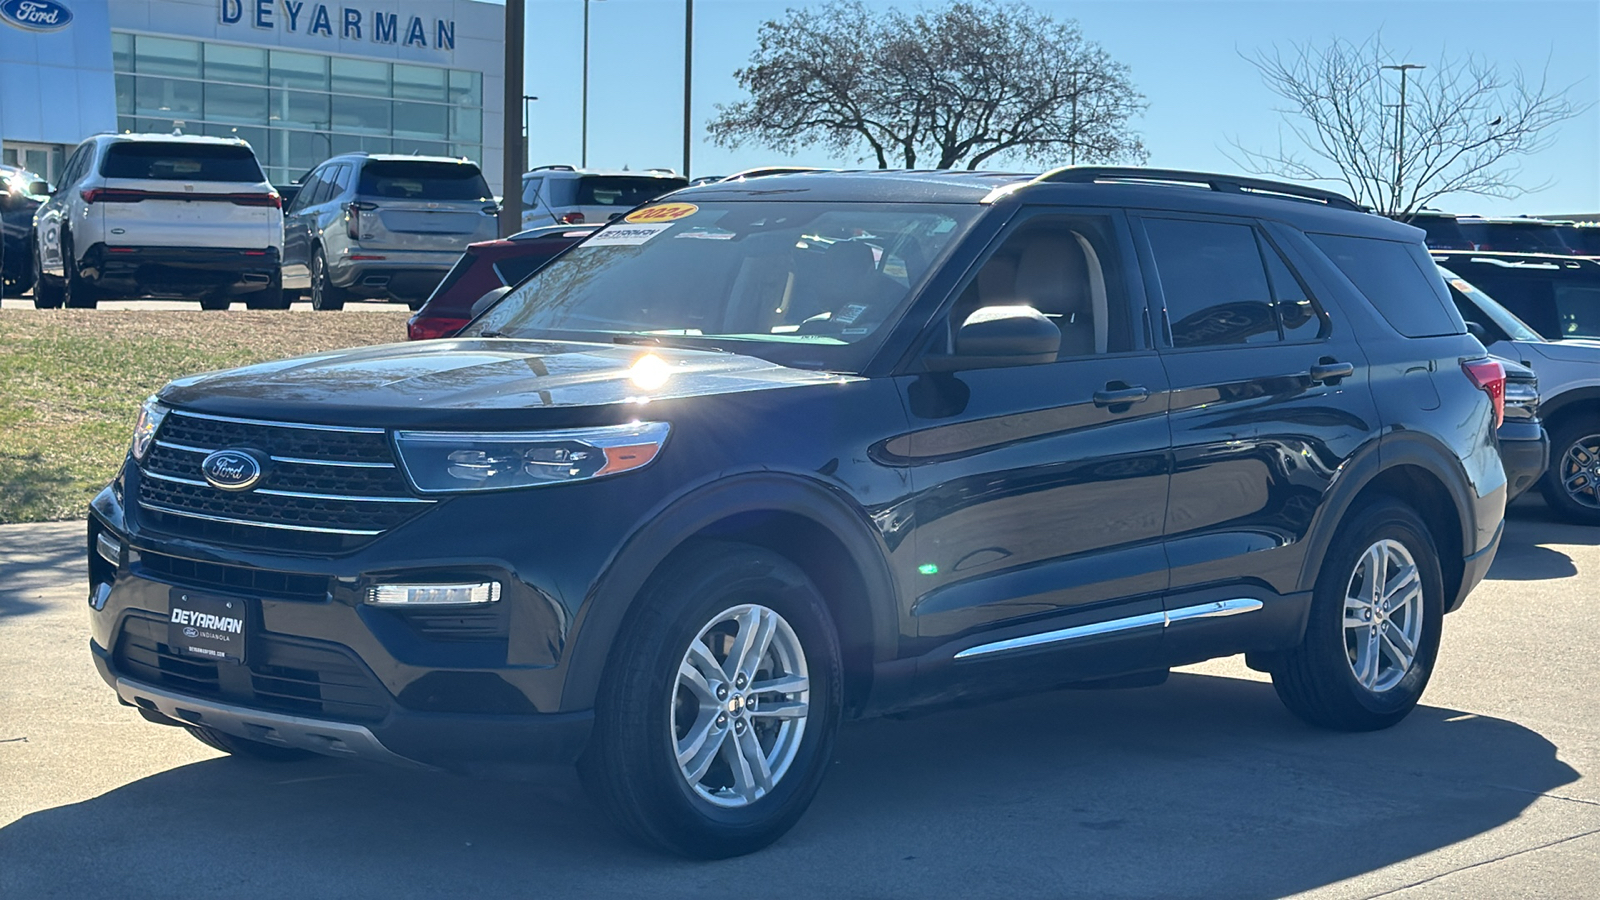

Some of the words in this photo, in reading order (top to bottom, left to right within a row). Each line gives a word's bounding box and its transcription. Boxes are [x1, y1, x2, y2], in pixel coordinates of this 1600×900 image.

[16, 1, 59, 24] Ford
[221, 0, 455, 50] DEYARMAN
[630, 206, 694, 220] 2024
[212, 457, 244, 479] Ford
[171, 608, 243, 634] DEYARMAN
[200, 631, 230, 641] INDIANOLA
